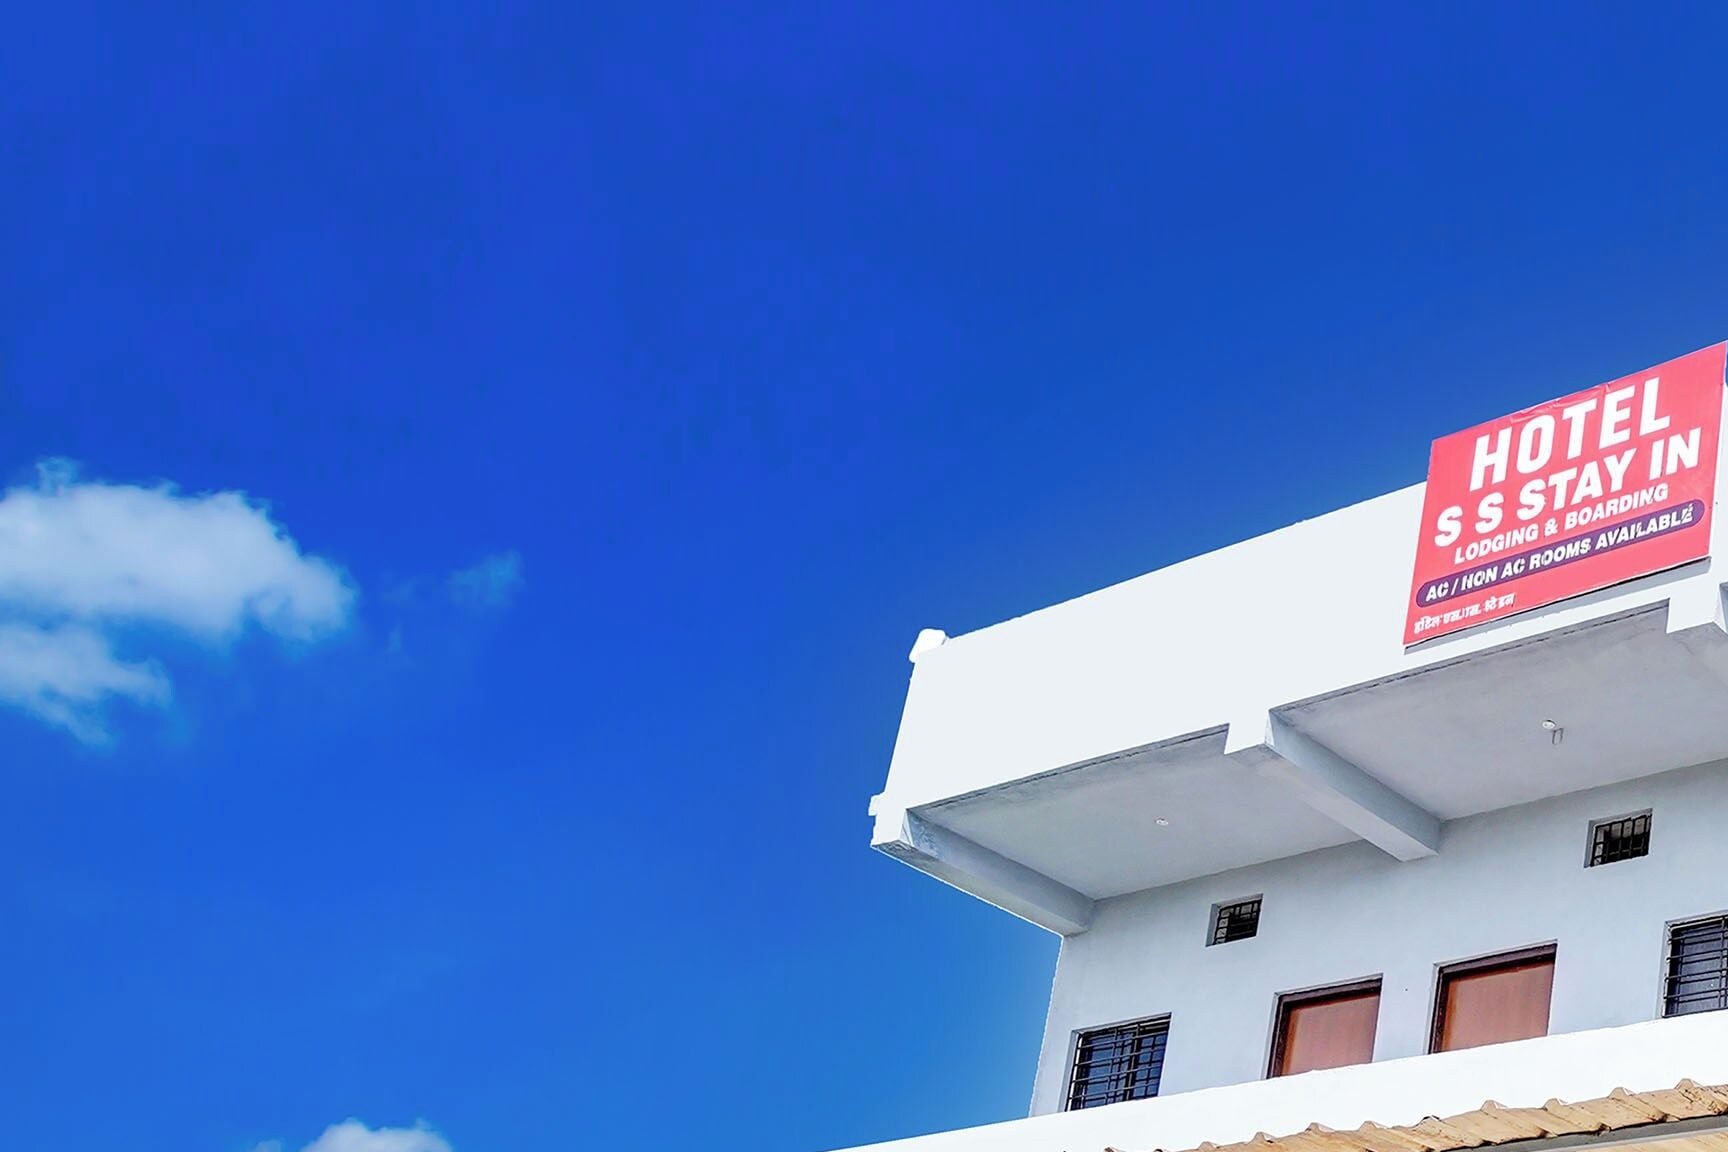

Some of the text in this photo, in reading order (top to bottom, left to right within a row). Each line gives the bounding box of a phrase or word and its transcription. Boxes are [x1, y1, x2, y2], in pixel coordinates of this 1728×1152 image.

[1434, 427, 1702, 548] S S STAY IN
[1469, 377, 1670, 492] HOTEL
[1425, 582, 1449, 602] AC
[1461, 567, 1498, 591] NON
[1501, 558, 1526, 579] AC
[1529, 540, 1592, 570] ROOMS
[1594, 503, 1694, 550] AVAILABLE
[1454, 483, 1669, 564] LODGING & BOARDING
